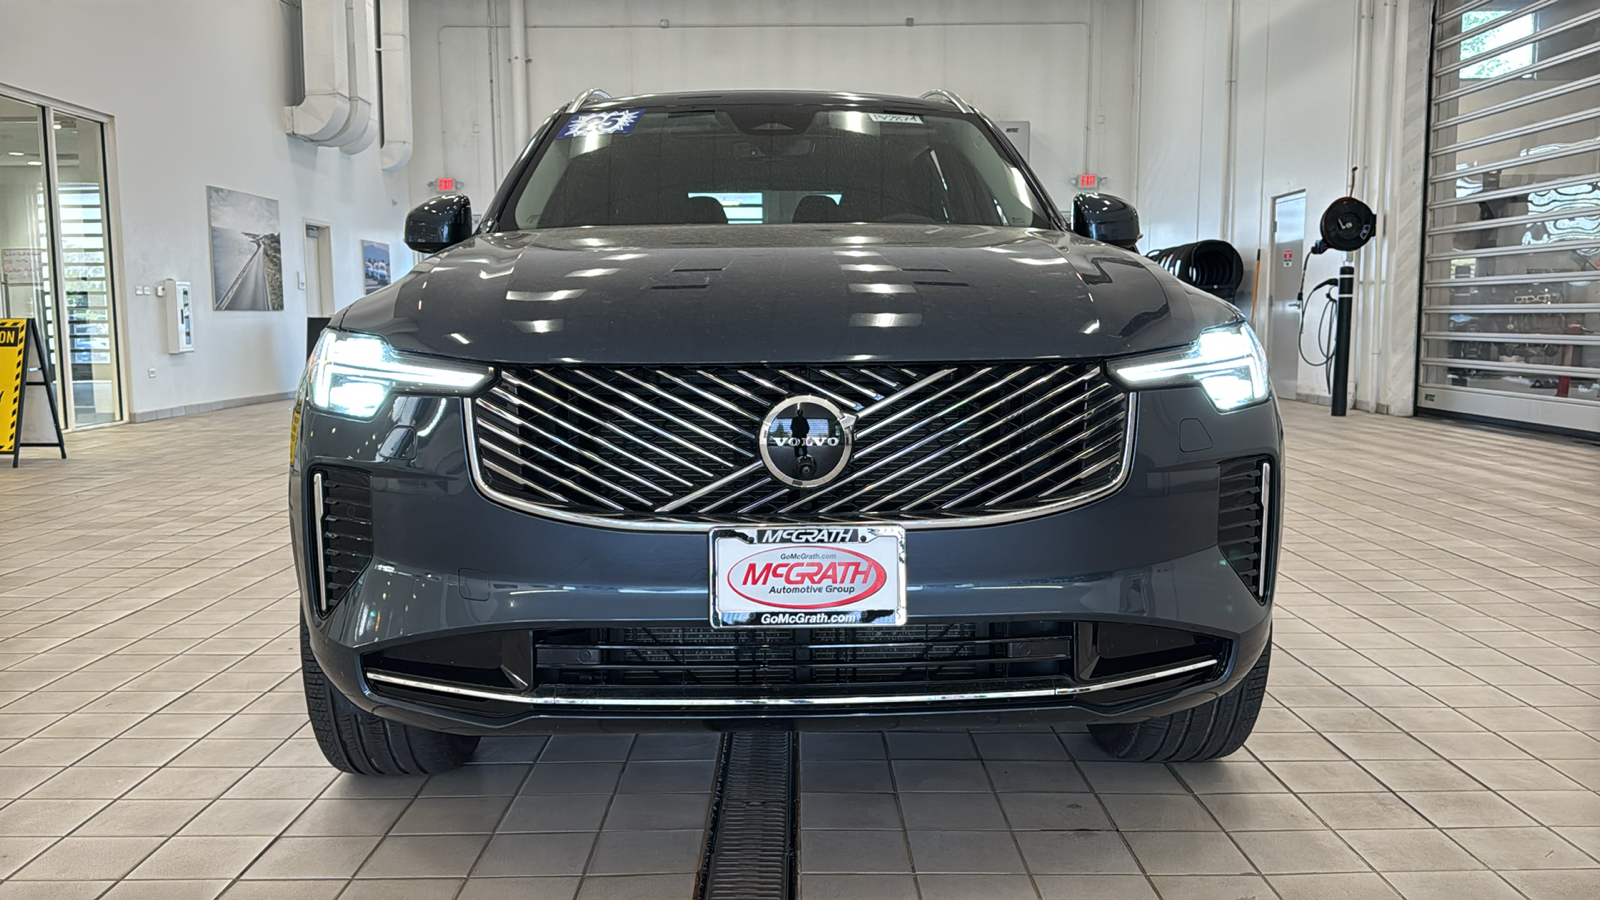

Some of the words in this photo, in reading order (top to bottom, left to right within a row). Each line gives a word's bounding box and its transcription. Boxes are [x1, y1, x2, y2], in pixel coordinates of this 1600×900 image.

[1081, 174, 1096, 187] EXIT
[772, 436, 840, 447] VOLVO
[780, 552, 836, 560] GoMcGrath.com
[768, 585, 823, 594] Automotive
[825, 585, 856, 595] Group
[760, 613, 856, 625] GoMcGrath.com
